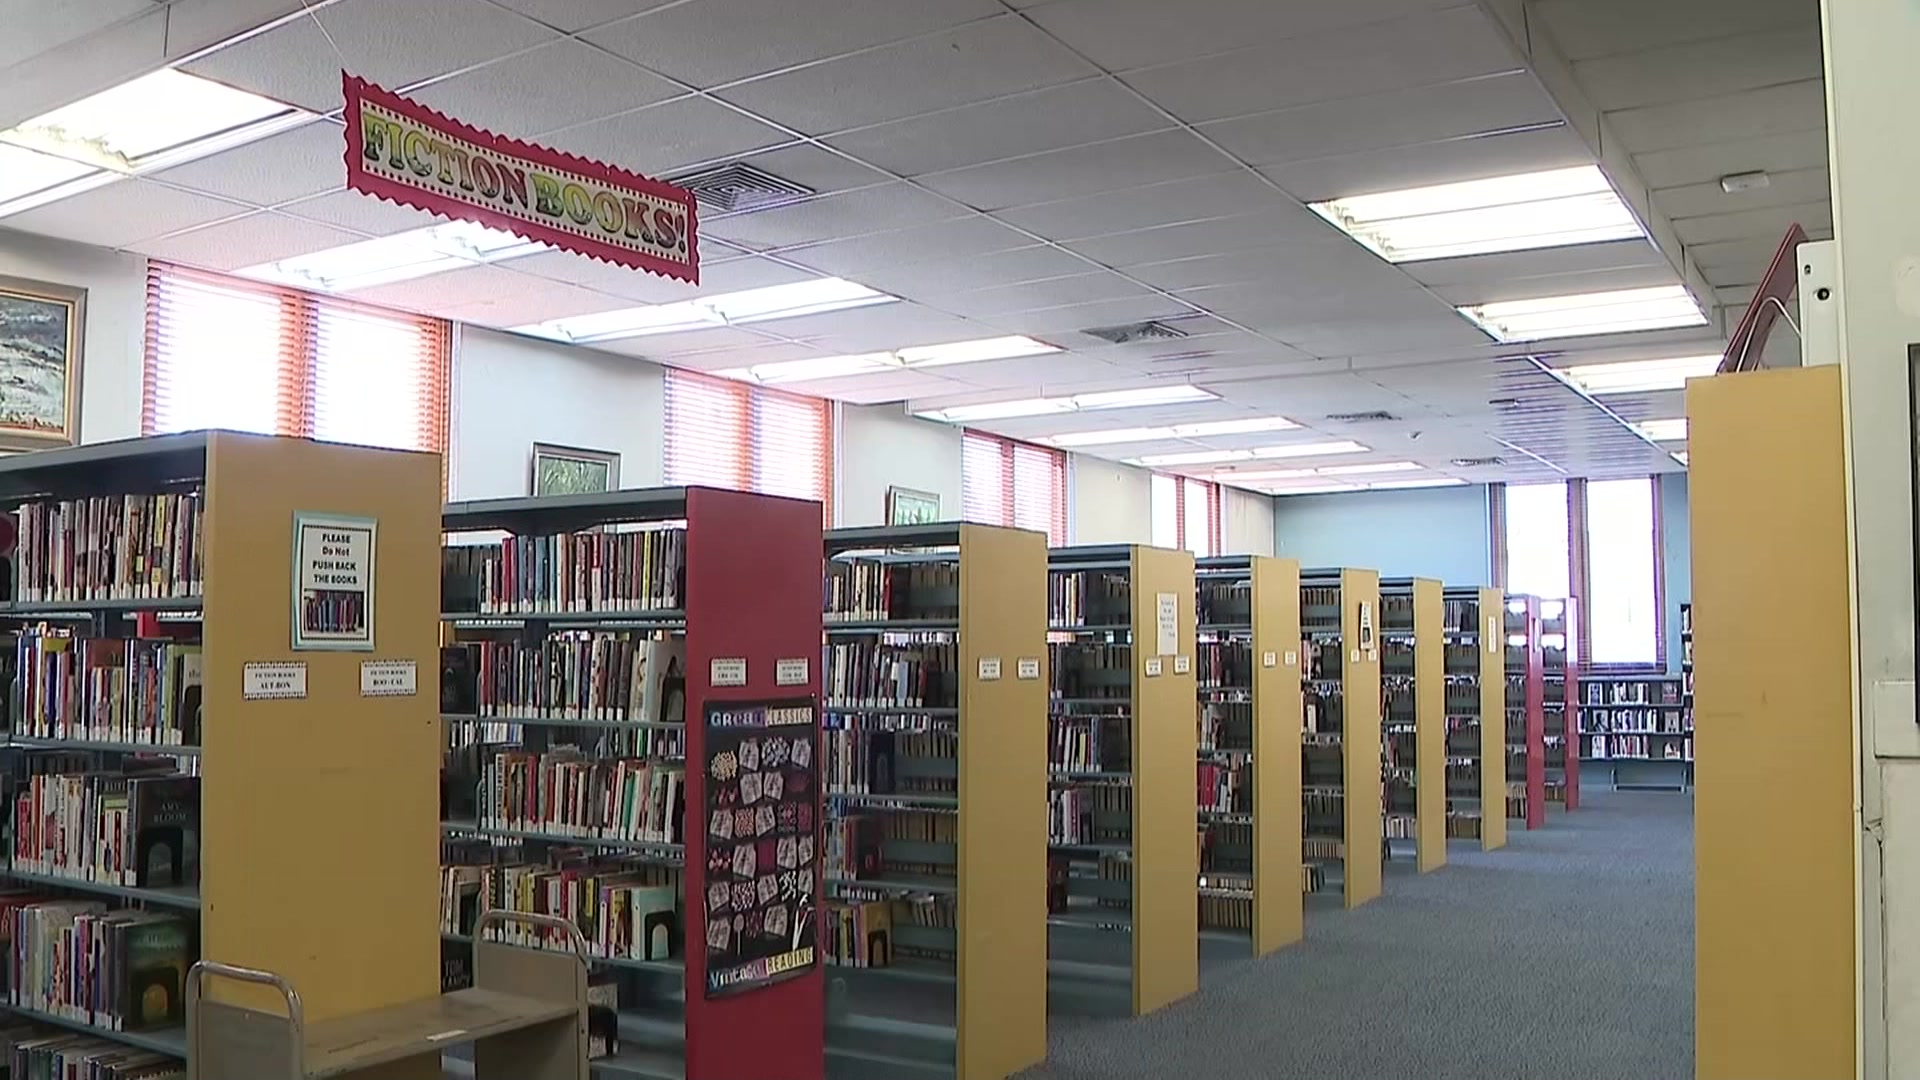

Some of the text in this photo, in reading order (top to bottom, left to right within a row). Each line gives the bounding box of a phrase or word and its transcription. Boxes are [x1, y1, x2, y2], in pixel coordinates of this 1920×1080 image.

[362, 110, 687, 254] FICTION BOOKS!
[322, 533, 351, 544] PLEASE
[322, 546, 350, 557] Do Not
[312, 560, 357, 571] PUSH BACK
[313, 574, 357, 585] THE BOOKS
